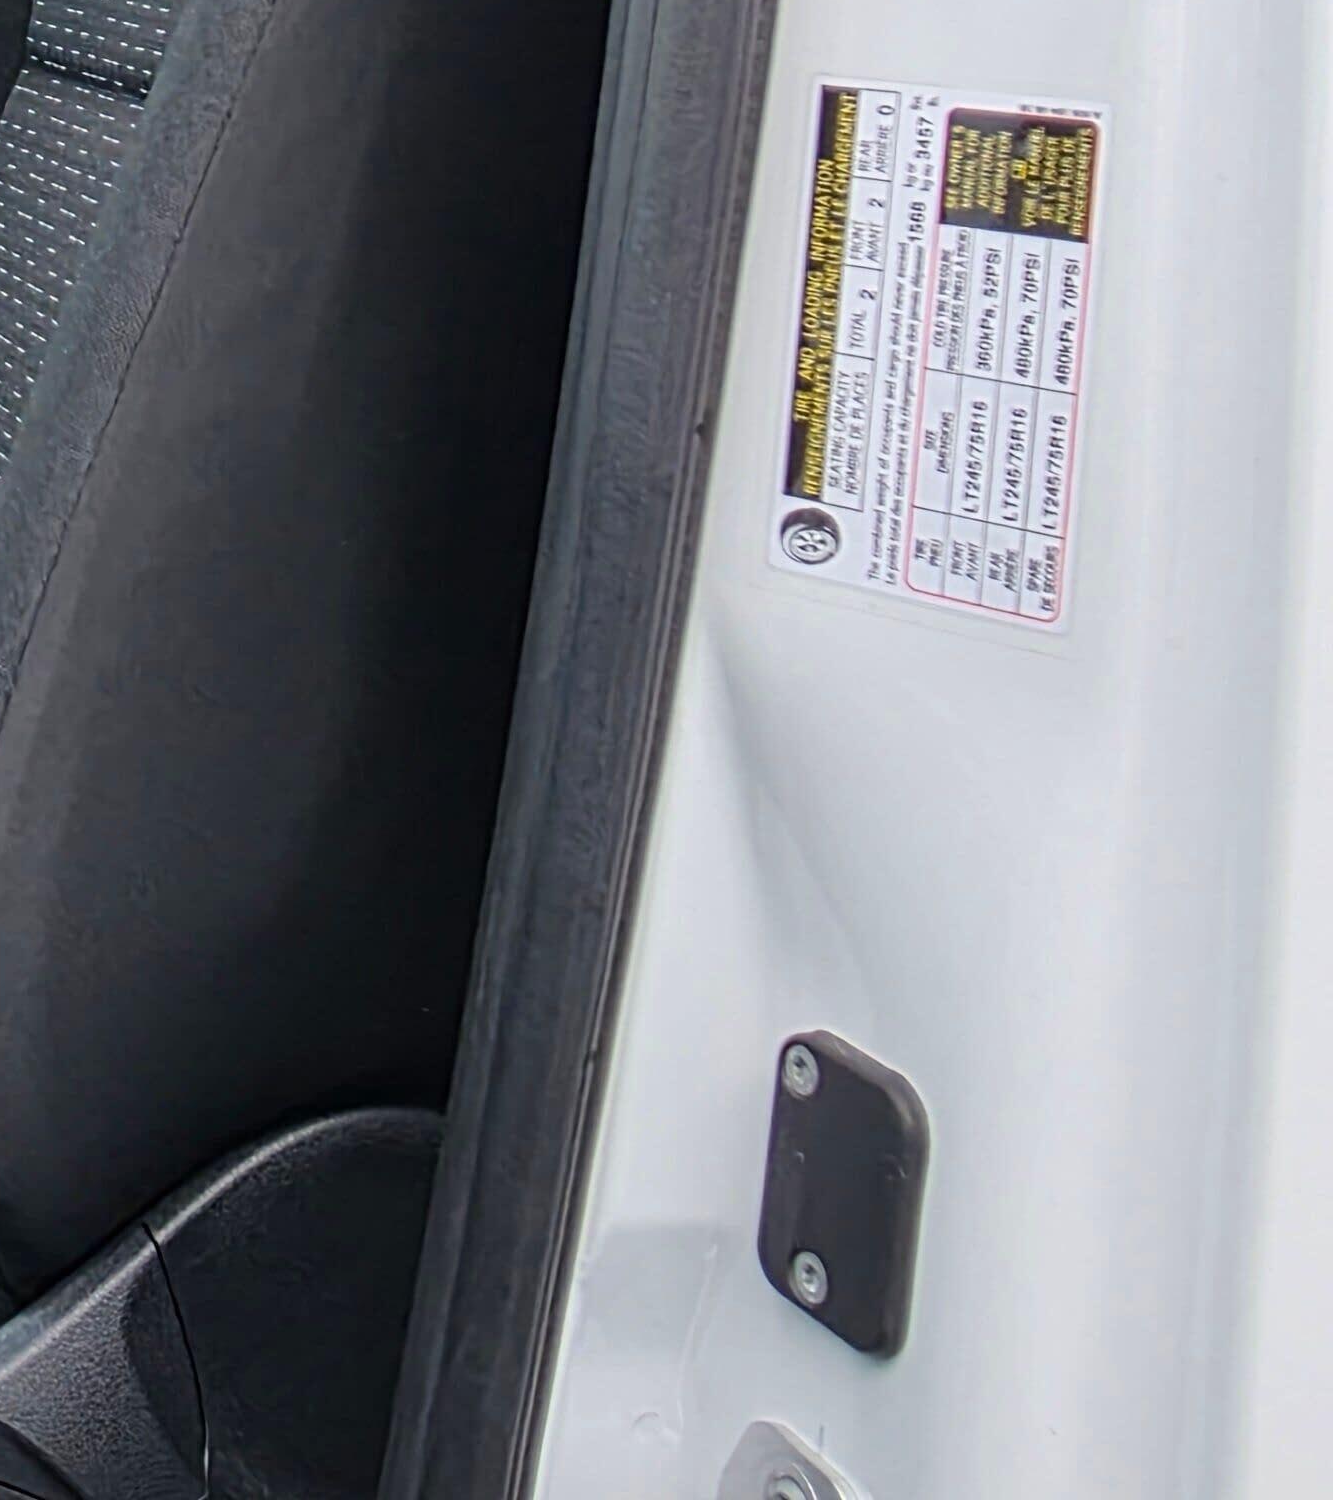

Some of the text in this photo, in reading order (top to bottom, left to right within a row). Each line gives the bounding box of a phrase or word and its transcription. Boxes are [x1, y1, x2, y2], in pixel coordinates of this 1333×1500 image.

[876, 103, 895, 116] 0
[913, 116, 934, 159] 3457
[856, 139, 873, 172] REAR
[960, 129, 980, 208] MANUAL FOR
[975, 134, 995, 207] ADDITIONAL
[991, 130, 1013, 214] INFORMATION
[866, 196, 885, 262] AVANT 2
[906, 200, 926, 243] 1568
[944, 186, 959, 208] SEE
[848, 219, 865, 260] FRONT
[792, 158, 834, 422] TIRE AND LOADING INFORMATION
[802, 92, 858, 495] RENSEIGNEMENTS SUR LES PNEUS ET LE CHARGEMENT
[849, 288, 876, 350] TOTAL 2
[932, 248, 952, 347] COLD TIRE PRESSURE
[974, 246, 1003, 372] 360kPa, 52PSI
[1012, 251, 1042, 379] 480kPa, 70PSI
[1051, 257, 1082, 385] 480kPa, 70PSI
[826, 370, 851, 488] SEATING CAPACITY
[844, 370, 869, 494] NOMBRE DE PLACES
[923, 428, 938, 451] SIZE
[936, 410, 955, 474] DIMENSIONS
[960, 398, 990, 514] LT245/75R16
[1000, 406, 1029, 522] LT245/75R16
[1039, 413, 1069, 531] LT245/75R16
[913, 537, 926, 560] TIRE
[927, 537, 944, 568] PNEU
[950, 539, 965, 576] FRONT
[964, 541, 981, 581] AVANT
[987, 551, 1002, 581] REAR
[1024, 557, 1042, 592] SPARE
[1041, 543, 1060, 613] DE SECOURS
